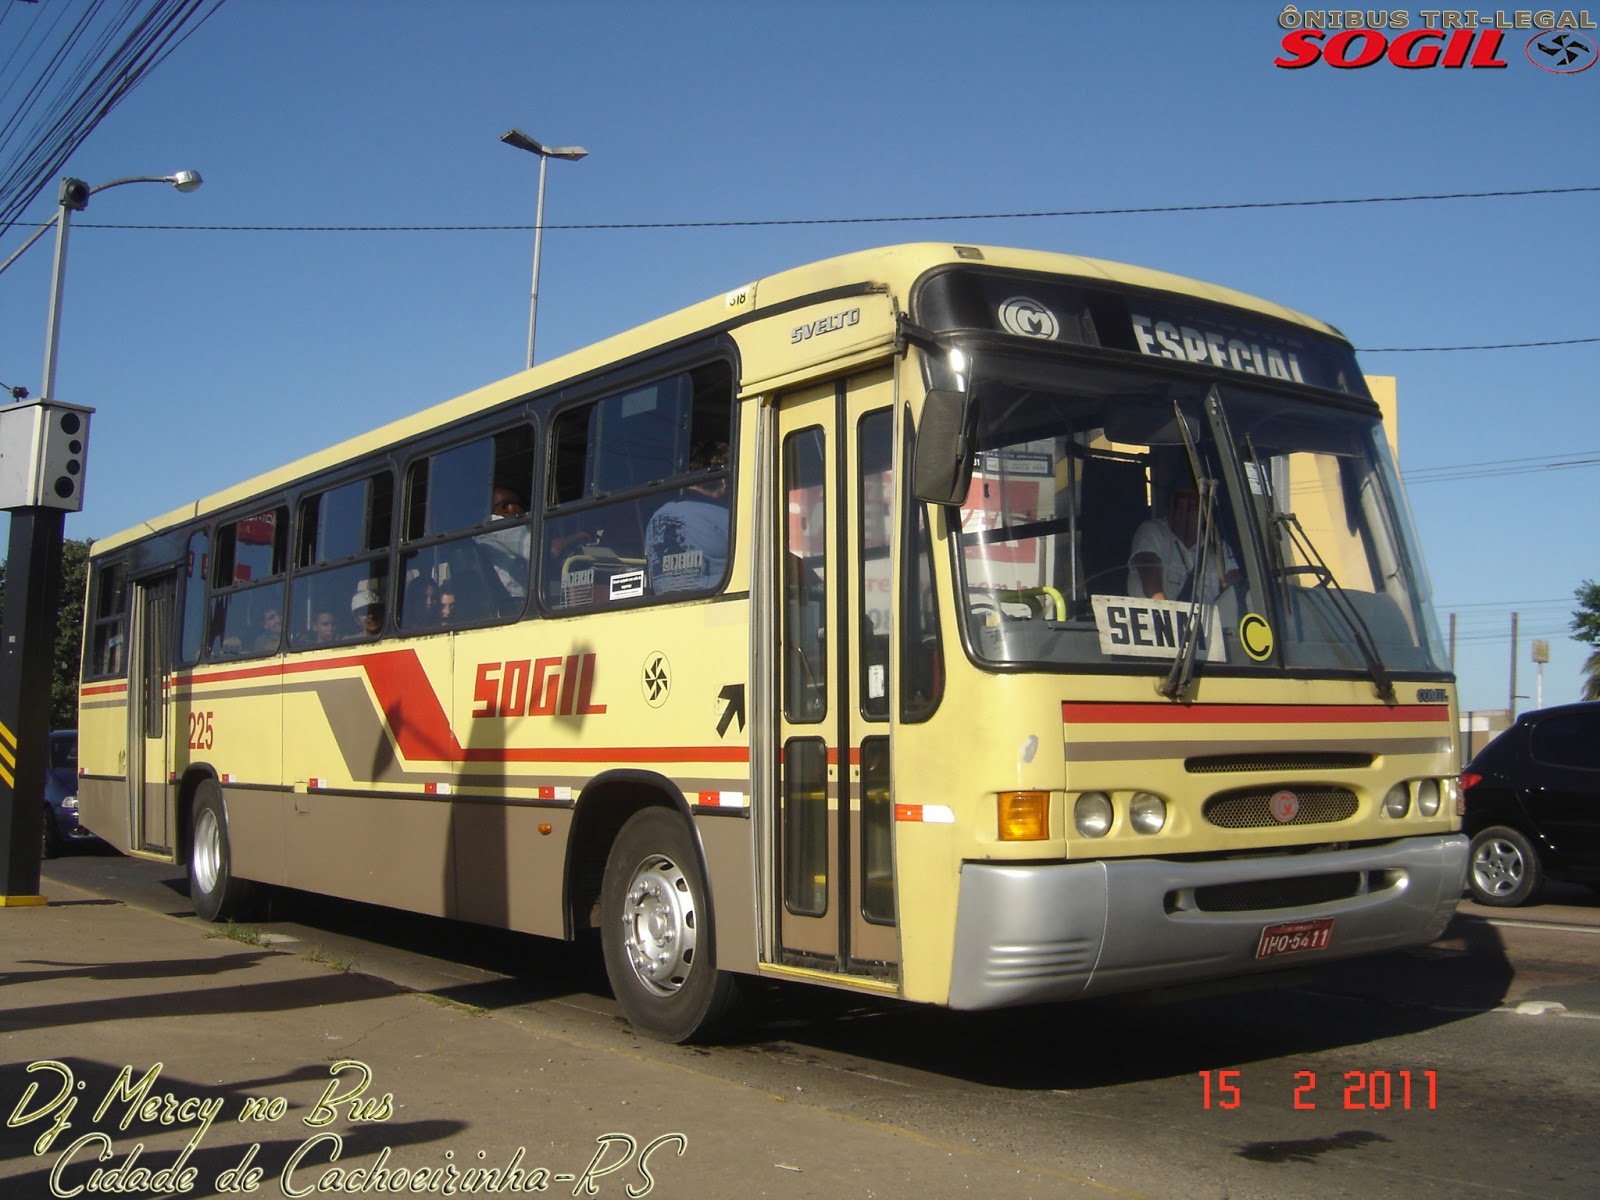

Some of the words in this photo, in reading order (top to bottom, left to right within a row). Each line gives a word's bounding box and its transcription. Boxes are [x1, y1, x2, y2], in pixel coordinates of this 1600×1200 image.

[790, 308, 860, 345] SVELTO
[472, 653, 608, 718] SOGIL
[188, 711, 214, 750] 225
